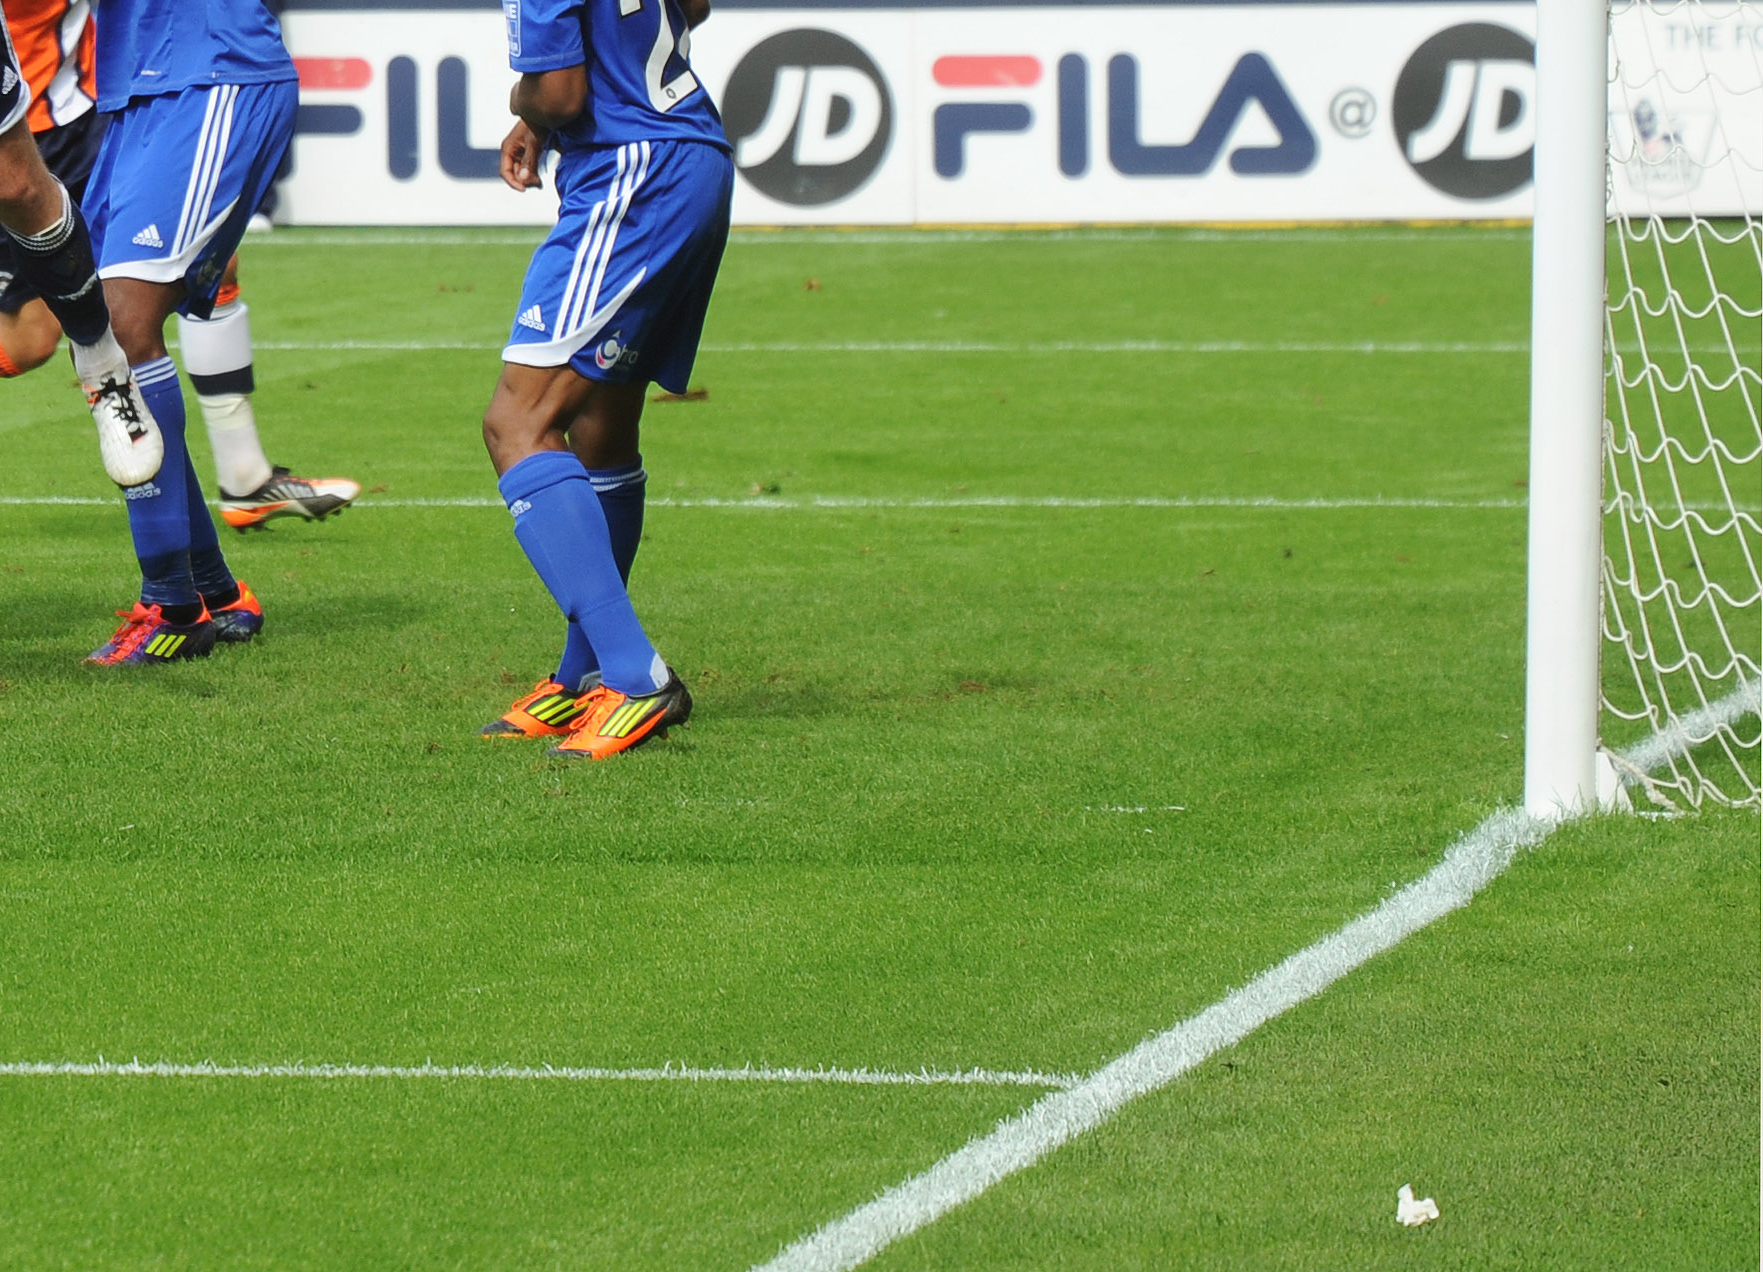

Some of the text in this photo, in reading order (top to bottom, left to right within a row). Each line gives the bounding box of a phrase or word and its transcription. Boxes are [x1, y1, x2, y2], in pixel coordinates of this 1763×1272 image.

[281, 55, 501, 180] FIL
[739, 65, 883, 167] JD
[932, 50, 1320, 181] FILA
[1328, 88, 1377, 139] @
